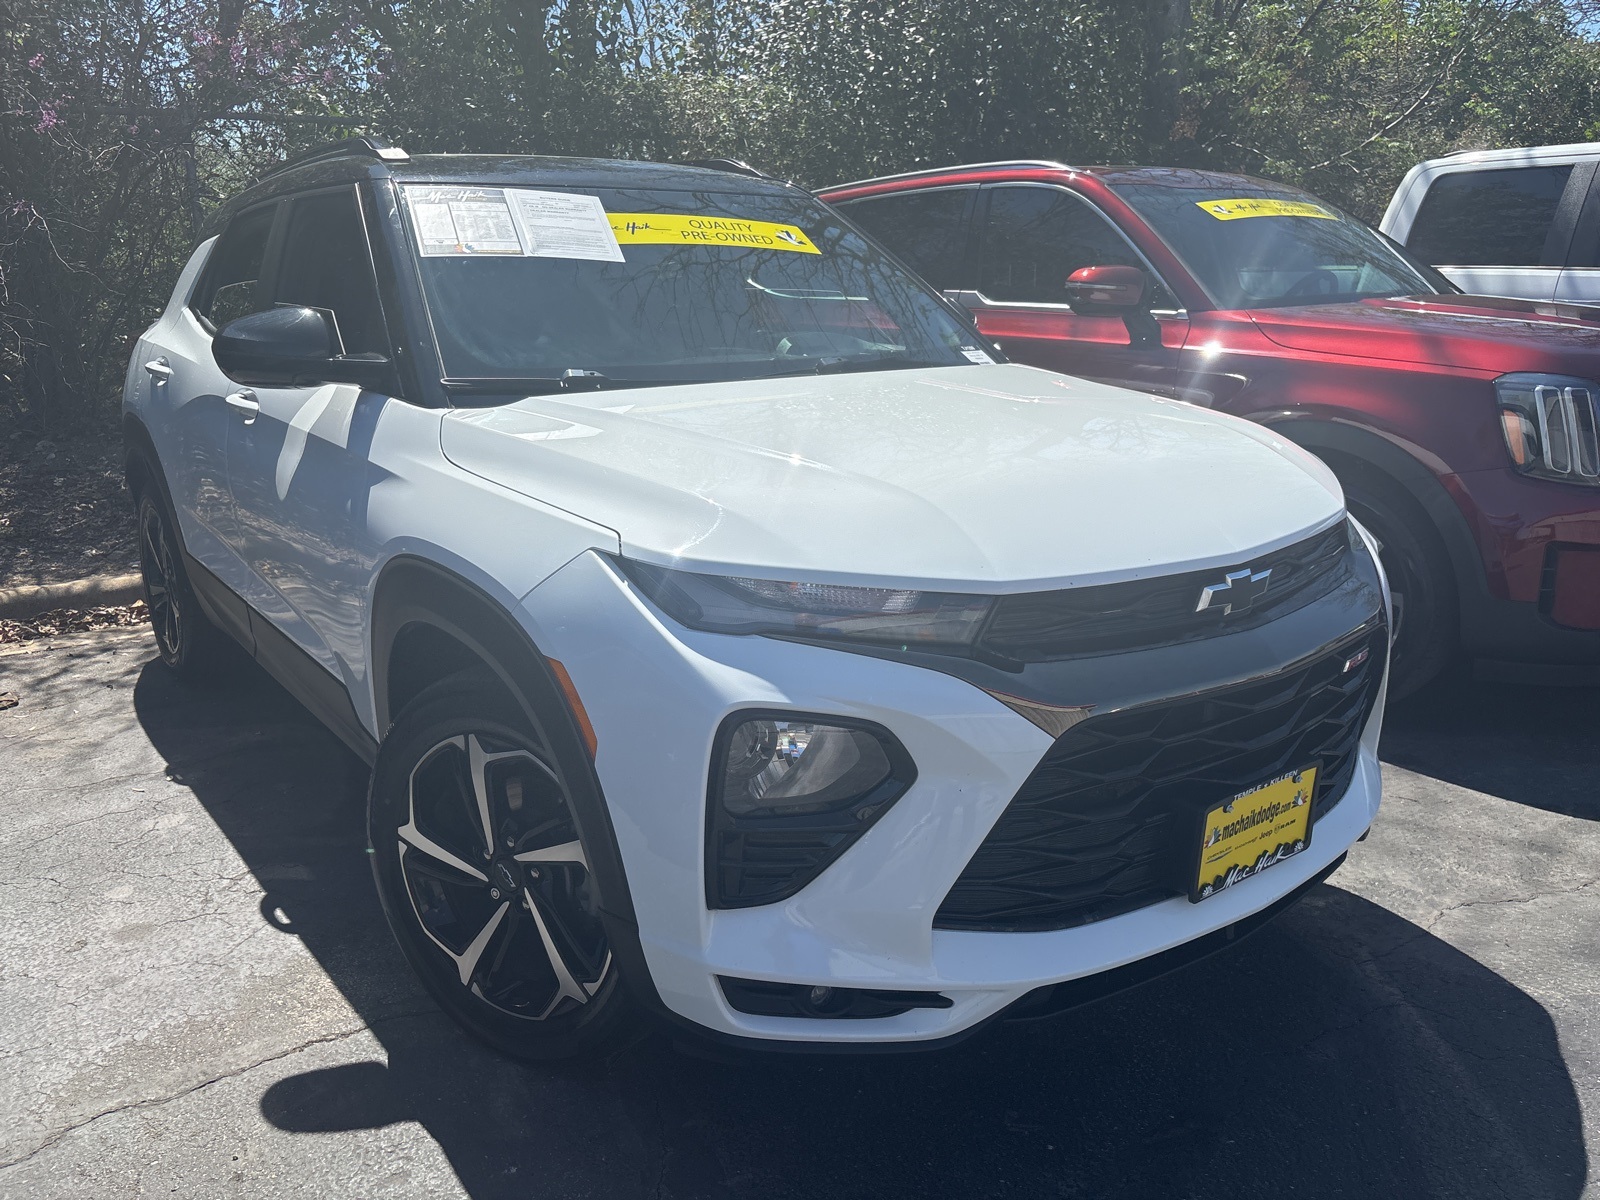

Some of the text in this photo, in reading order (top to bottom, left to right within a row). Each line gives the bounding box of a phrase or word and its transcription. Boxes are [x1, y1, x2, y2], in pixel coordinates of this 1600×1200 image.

[626, 222, 659, 235] Haik
[689, 219, 753, 232] QUALITY
[681, 230, 774, 245] PRE-OWNED
[1234, 784, 1262, 801] TEMPLE
[1270, 769, 1298, 786] KILLEEN
[1221, 801, 1292, 841] machaikdodge.com
[1259, 829, 1273, 840] Jeep
[1222, 845, 1286, 888] Mac Haik
